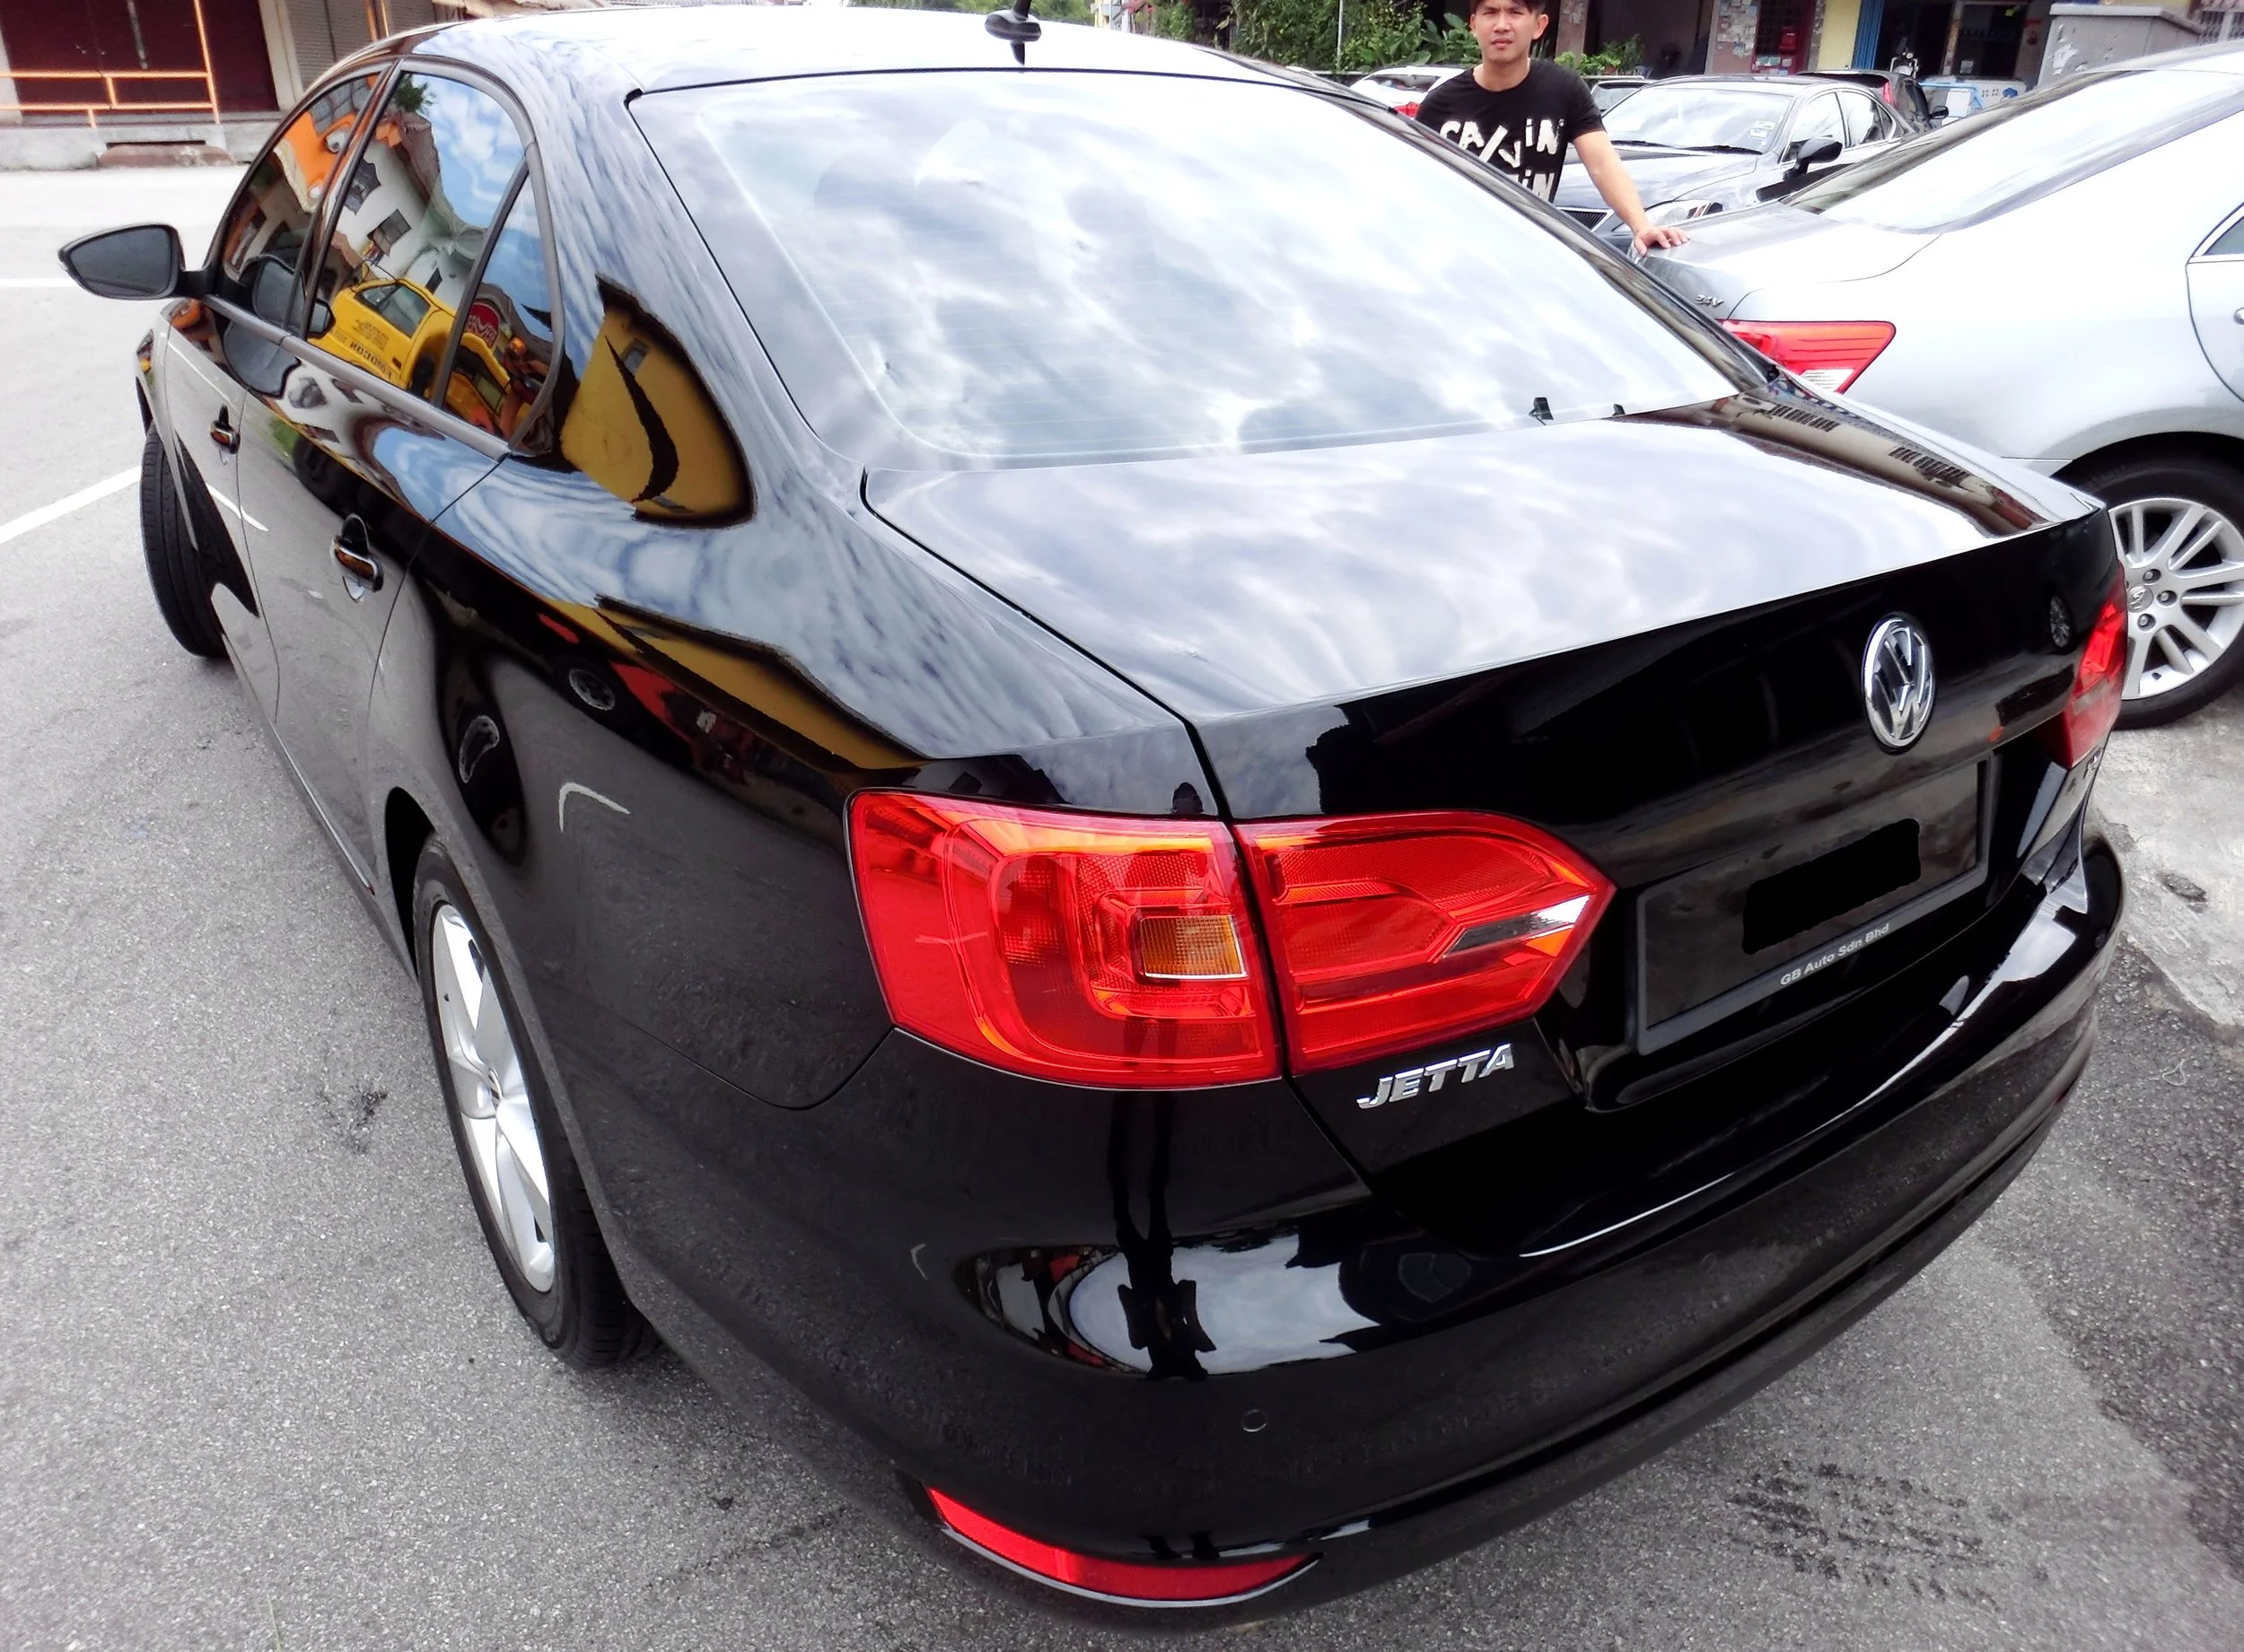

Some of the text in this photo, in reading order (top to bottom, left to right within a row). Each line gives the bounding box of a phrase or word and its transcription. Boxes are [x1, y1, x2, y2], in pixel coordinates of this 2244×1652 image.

[1780, 923, 1889, 985] GB Auto Sdn Bhd
[1356, 1043, 1515, 1109] JETTA
